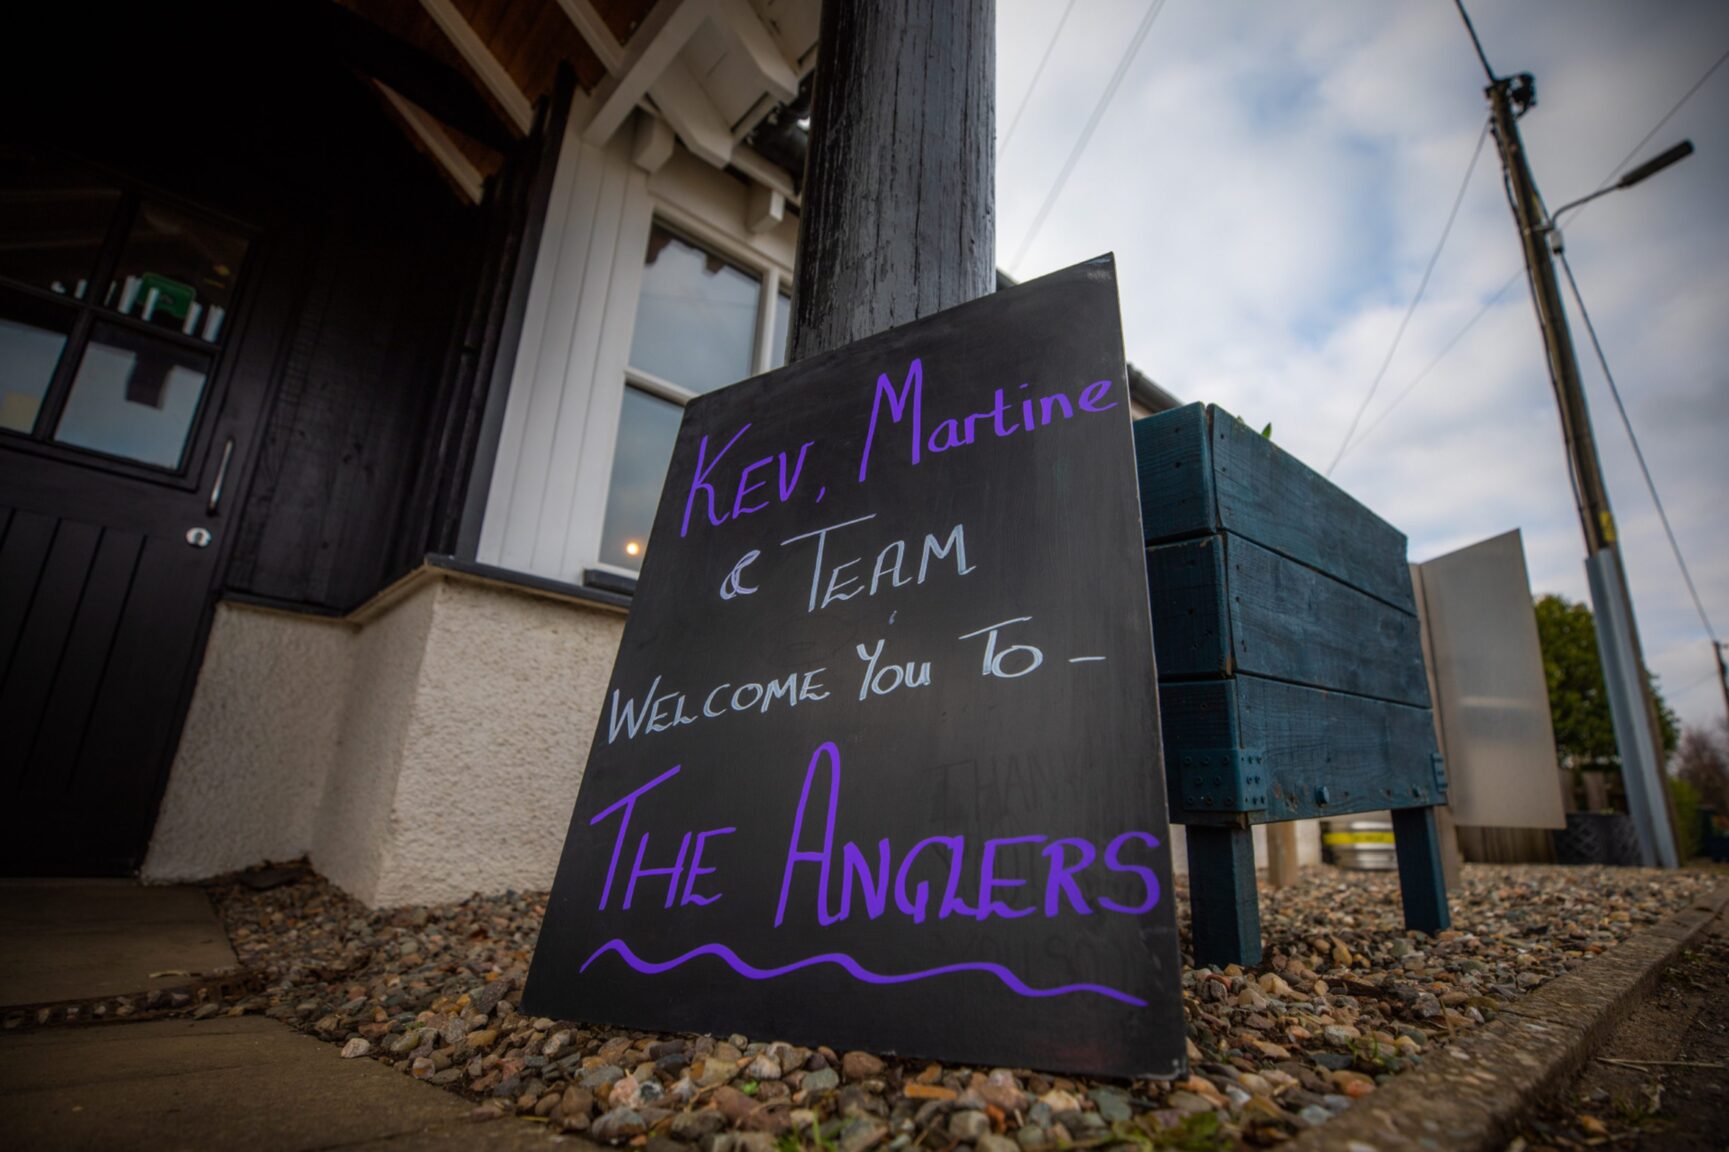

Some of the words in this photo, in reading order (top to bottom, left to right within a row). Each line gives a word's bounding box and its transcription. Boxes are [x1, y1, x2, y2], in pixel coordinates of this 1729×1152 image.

[857, 357, 1118, 483] Martine
[780, 514, 977, 613] TEAM
[608, 667, 831, 744] WELCOME
[588, 764, 737, 912] THE
[773, 740, 1161, 929] ANGLERS
